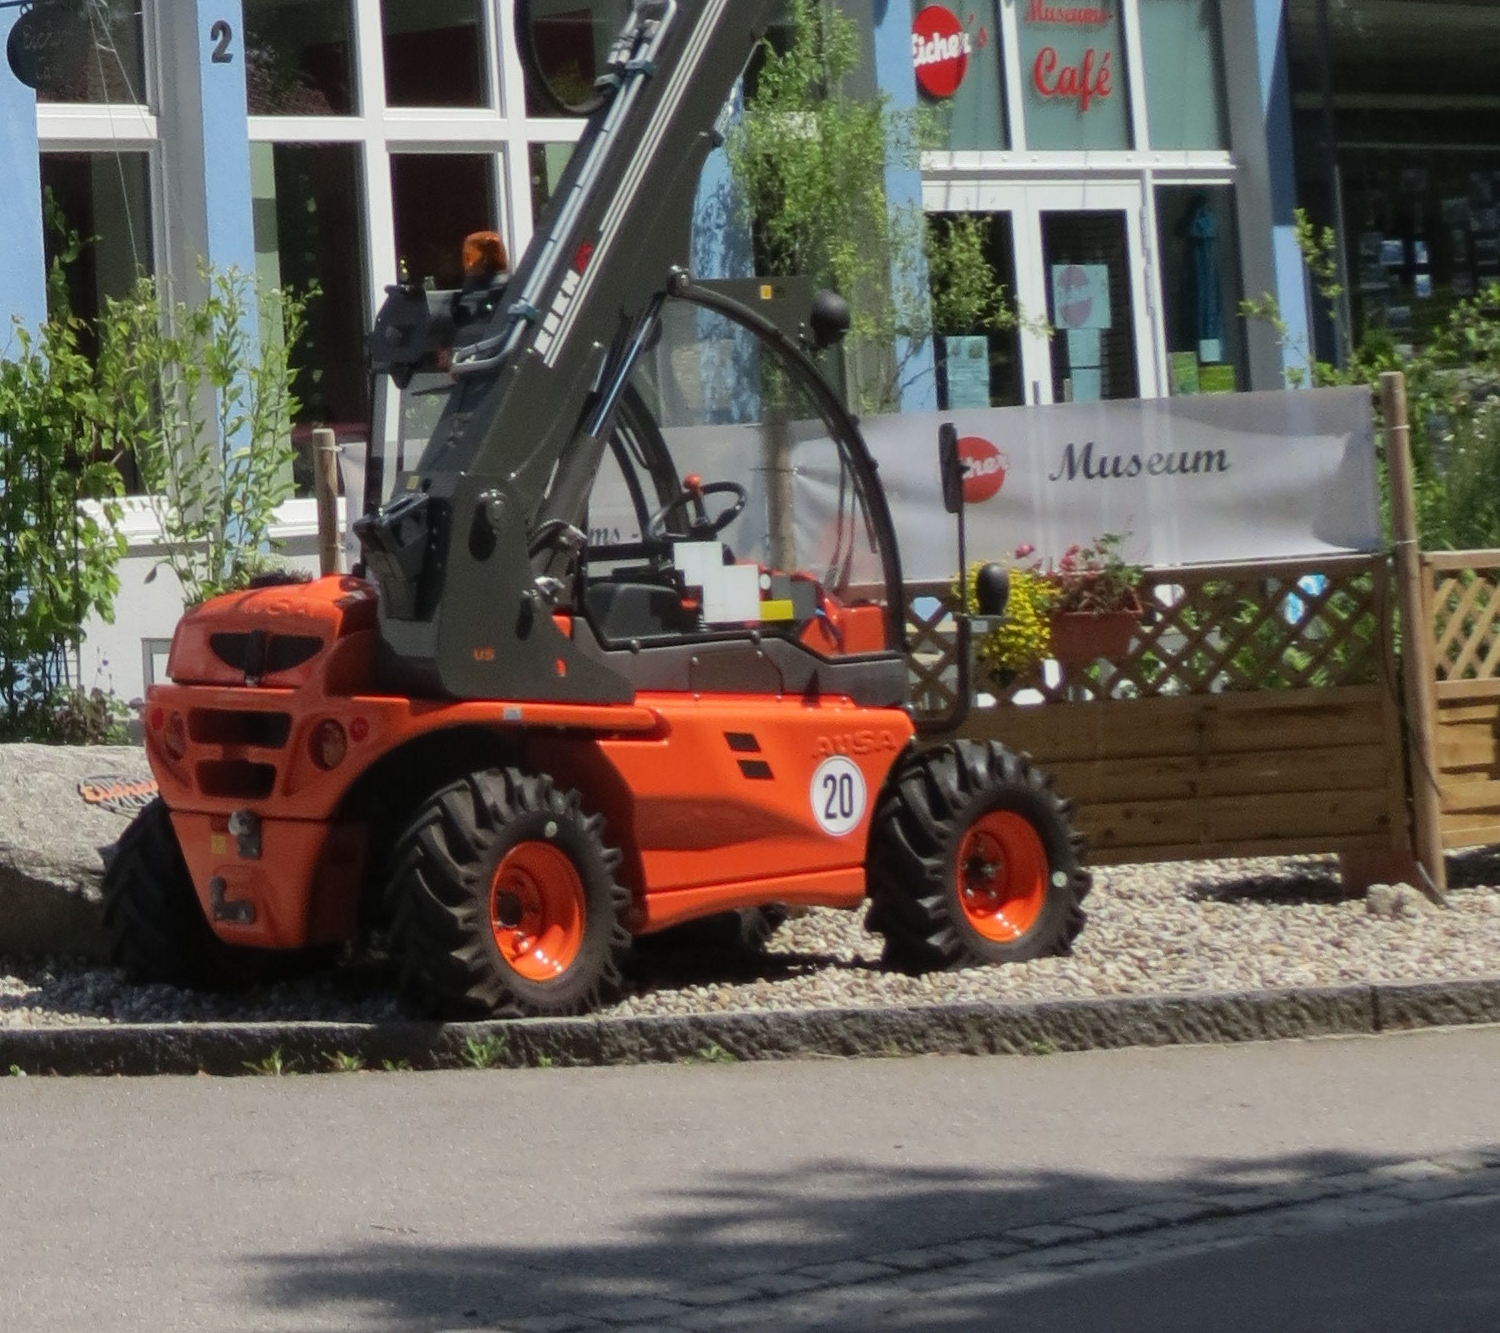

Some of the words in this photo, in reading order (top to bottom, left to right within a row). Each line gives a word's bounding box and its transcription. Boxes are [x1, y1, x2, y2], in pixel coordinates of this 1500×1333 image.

[210, 20, 234, 64] 2
[1034, 46, 1113, 113] Café
[1049, 441, 1231, 481] Museum
[822, 772, 854, 820] 20
